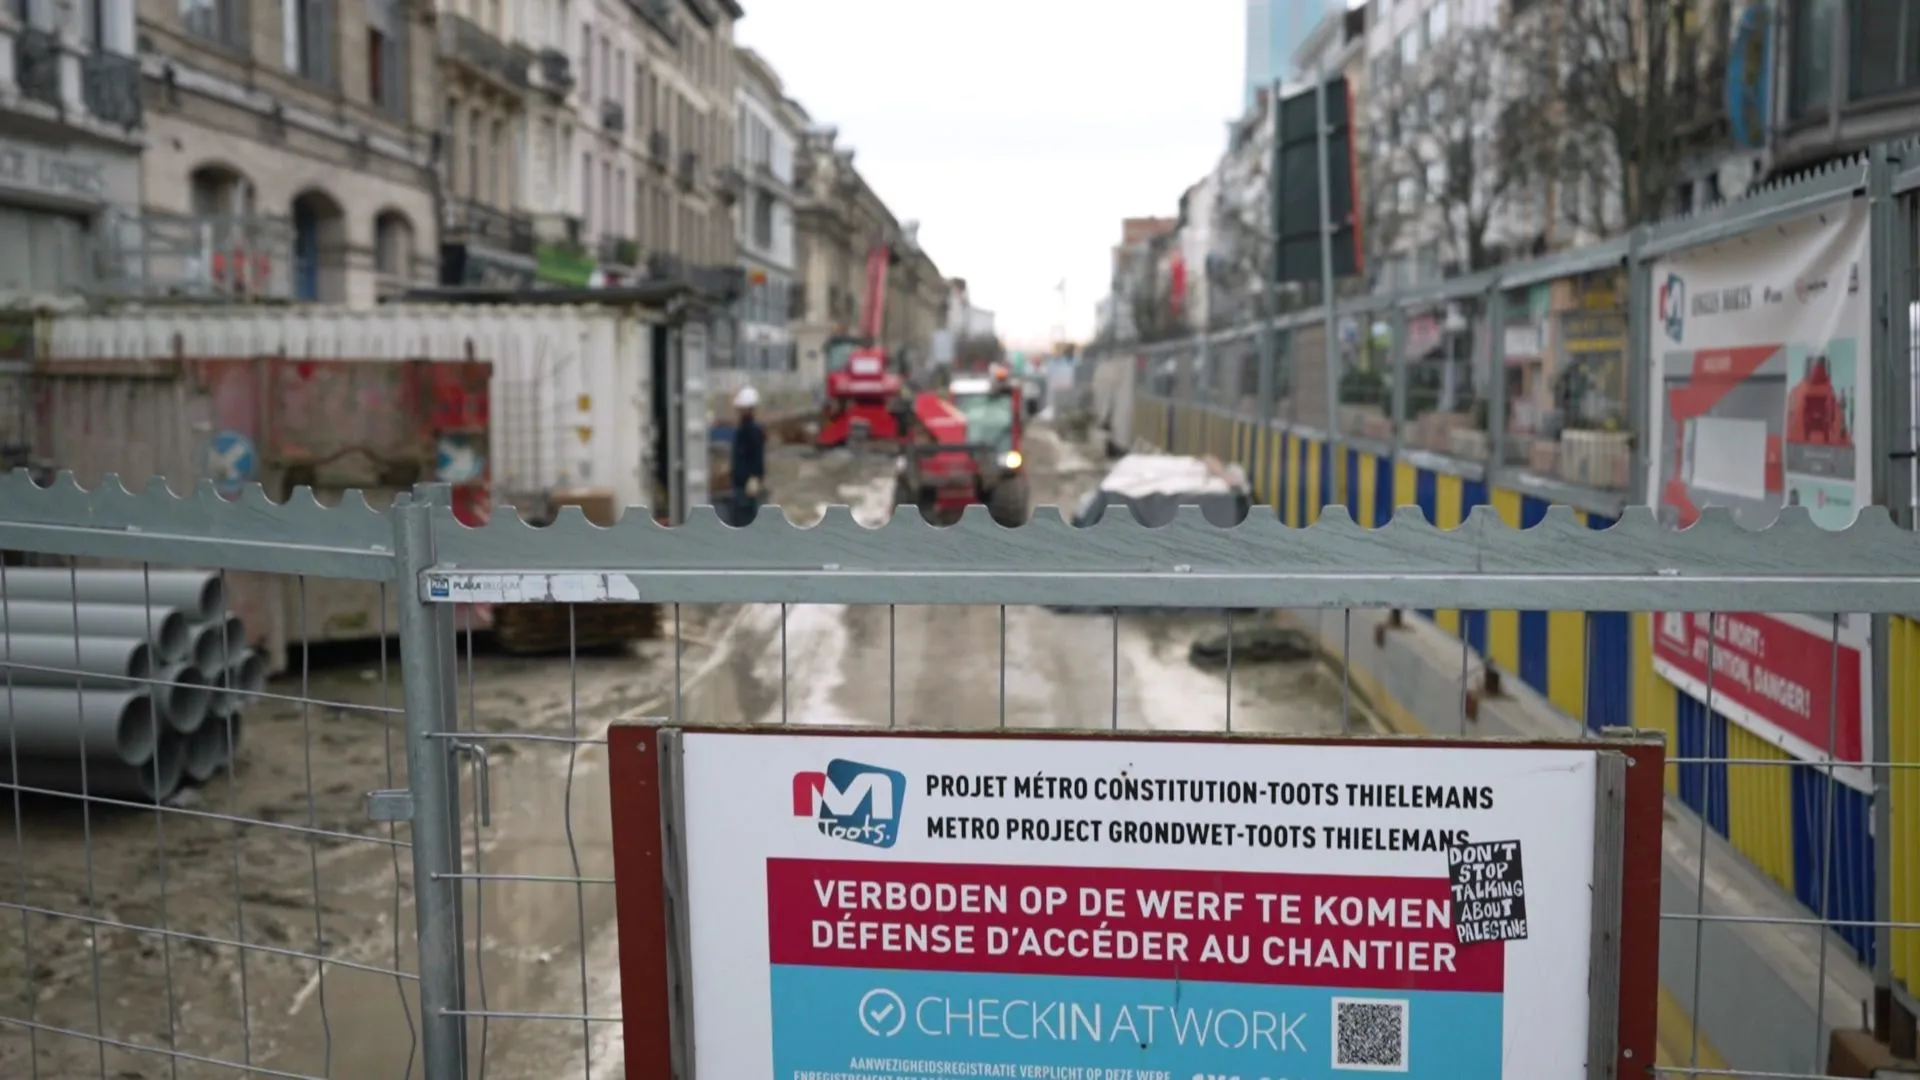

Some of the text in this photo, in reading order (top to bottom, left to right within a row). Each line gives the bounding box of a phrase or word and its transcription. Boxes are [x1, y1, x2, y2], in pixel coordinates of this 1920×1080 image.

[926, 771, 1494, 810] PROJET MÉTRO CONSTITUTION-TOOTS THIELEMANS
[927, 817, 1470, 852] METRO PROJECT GRONDWET-TOOTS THIELEMANS
[1449, 843, 1516, 866] DON'T
[1458, 862, 1508, 883] STOP
[1451, 880, 1523, 902] TALKING
[813, 879, 1451, 929] VERBODEN OP DE WERF TE KOMEN
[1461, 898, 1513, 922] ABOUT
[811, 914, 1457, 972] DÉFENSE D'ACCÉDER AU CHANTIER
[1456, 919, 1527, 943] PALESTINE
[850, 1056, 1017, 1077] AANWEZIGHEIDSREGISTRATIE
[1019, 1064, 1083, 1080] VERPLICHT
[1086, 1067, 1102, 1080] OP
